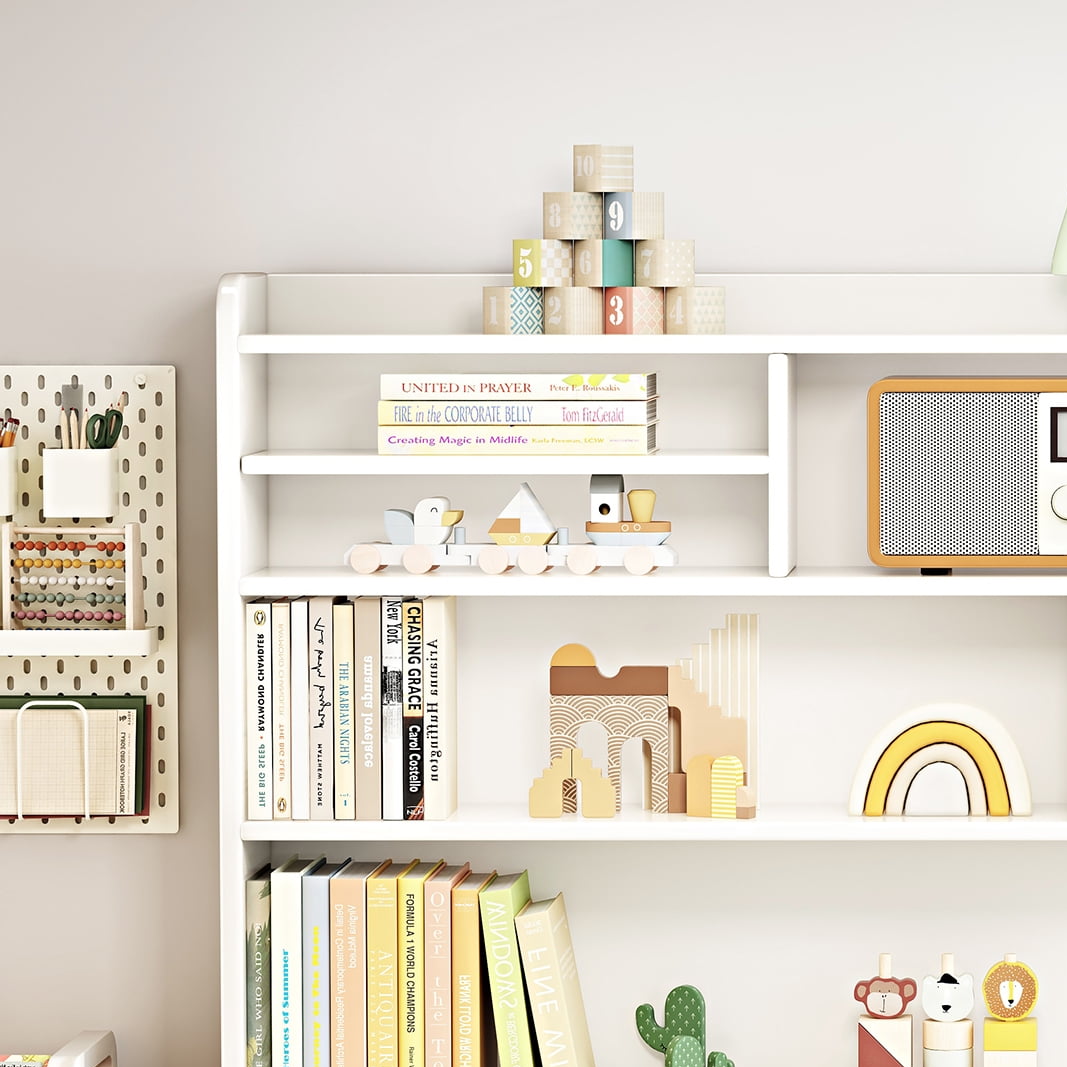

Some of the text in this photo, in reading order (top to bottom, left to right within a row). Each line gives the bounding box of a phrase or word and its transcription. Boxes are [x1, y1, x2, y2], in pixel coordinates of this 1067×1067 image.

[576, 155, 595, 177] 10
[549, 202, 562, 228] 8
[608, 201, 624, 232] 9
[518, 248, 533, 279] 5
[579, 250, 592, 276] 6
[640, 249, 656, 278] 7
[488, 296, 498, 325] 1
[547, 296, 562, 325] 2
[609, 295, 624, 326] 3
[669, 296, 684, 325] 4
[401, 382, 532, 393] UNITED IN PRAYER
[393, 405, 624, 423] FIRE in the CORPORATE BELLY Tom FitzGerald
[387, 435, 529, 446] Creating Magic in Midlife
[386, 600, 403, 620] New
[386, 623, 403, 645] York
[407, 607, 421, 664] CHASING
[407, 668, 422, 710] GRACE
[339, 663, 350, 765] THE ARABIAN NIGHTS
[408, 725, 421, 751] Carol
[409, 753, 421, 792] Costello
[405, 894, 415, 937] FORMULA
[430, 892, 445, 955] Over
[406, 946, 415, 978] WORLD
[406, 980, 417, 1033] CHAMPIONS
[431, 977, 445, 1020] the
[282, 1011, 289, 1024] of
